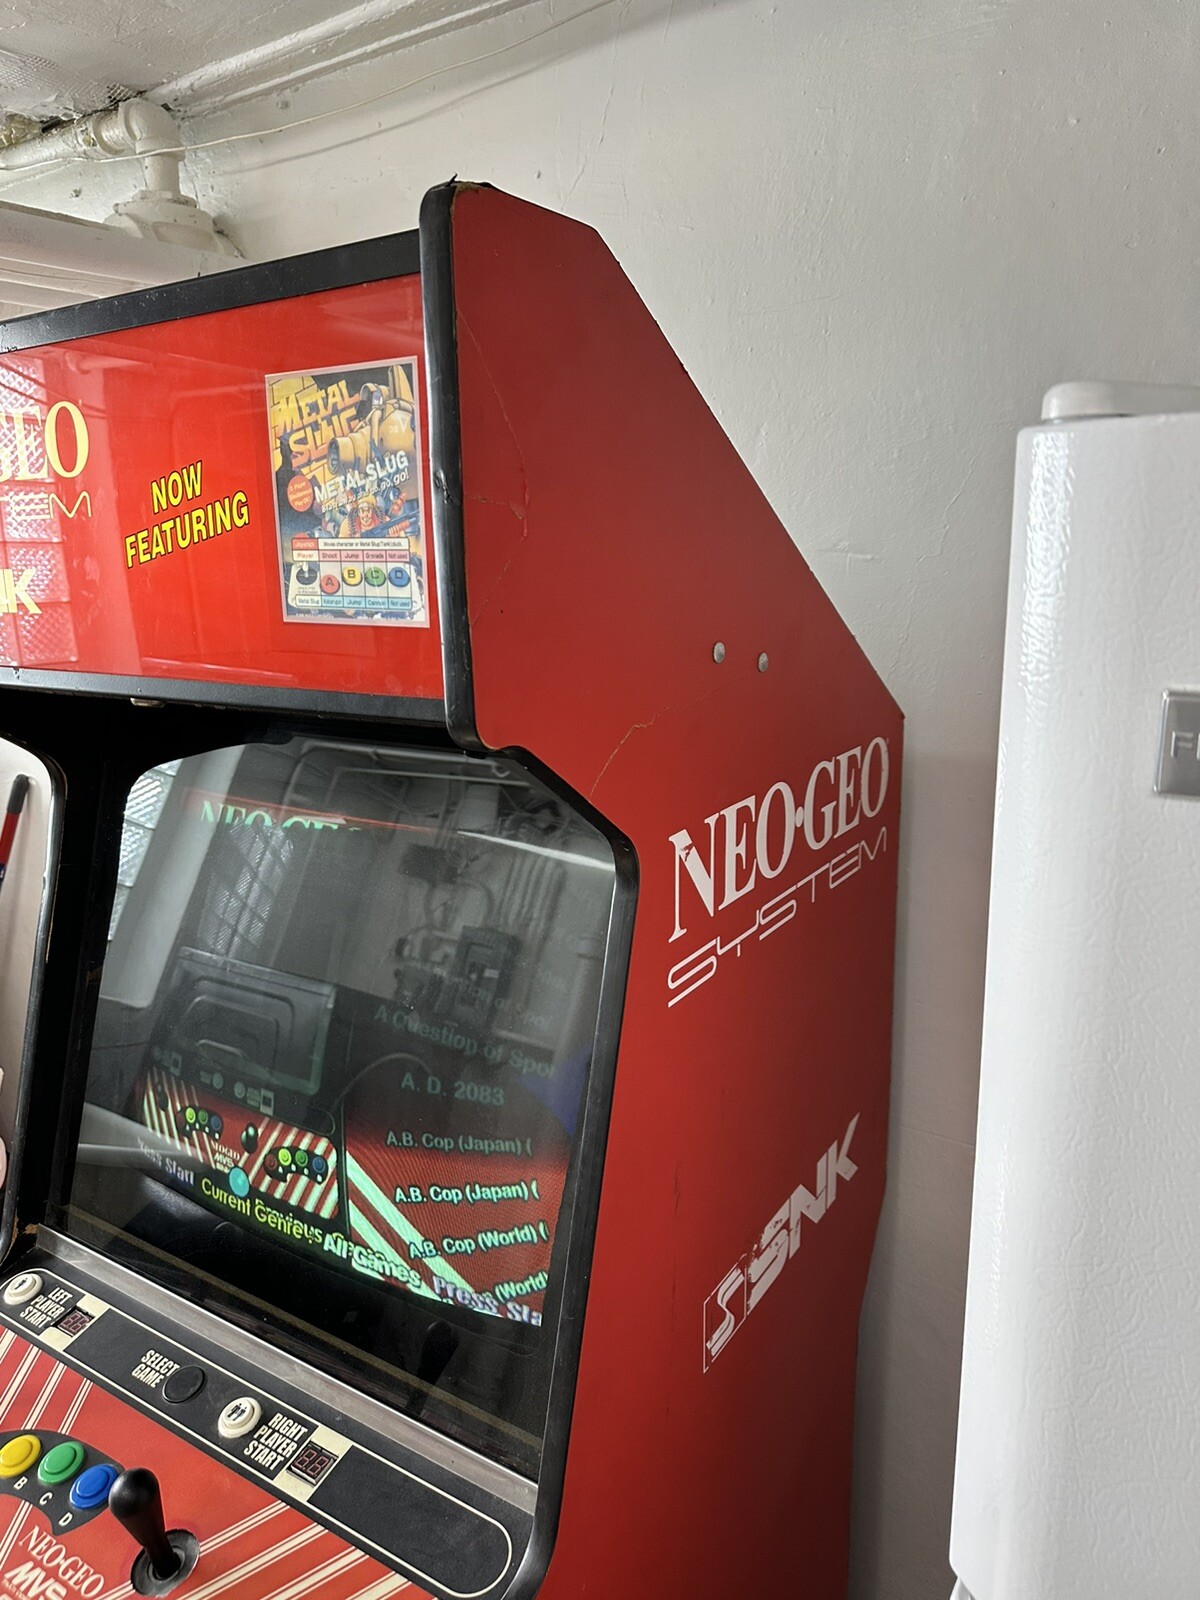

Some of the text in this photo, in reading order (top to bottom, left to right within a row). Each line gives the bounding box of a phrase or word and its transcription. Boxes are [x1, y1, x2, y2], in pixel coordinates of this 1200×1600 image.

[0, 401, 89, 484] EO
[150, 461, 203, 514] NOW
[314, 450, 409, 503] METAL SLUG
[125, 491, 250, 567] FEATURING
[344, 552, 360, 560] Jump
[325, 577, 335, 586] A
[347, 569, 356, 579] B
[370, 570, 380, 579] C
[394, 570, 404, 579] D
[667, 826, 887, 1008] SYSTEM
[454, 1080, 505, 1106] 2083
[387, 1130, 418, 1147] A.B.
[422, 1133, 455, 1151] Cop
[458, 1134, 521, 1155] (Japan)
[395, 1186, 427, 1203] A.B.
[429, 1184, 463, 1205] Cop
[465, 1181, 529, 1203] (Japan)
[201, 1177, 251, 1216] Current
[352, 1247, 423, 1288] Games
[408, 1241, 441, 1260] A.B.
[443, 1237, 477, 1256] Cop
[477, 1223, 538, 1249] (World)
[30, 1295, 66, 1319] PLAYER
[48, 1286, 73, 1305] LEFT
[433, 1275, 499, 1316] Press
[20, 1305, 52, 1329] START
[131, 1363, 165, 1389] GAME
[140, 1349, 181, 1377] SELECT
[267, 1412, 308, 1441] RIGHT
[253, 1424, 298, 1458] PLAYER
[243, 1440, 285, 1471] START
[13, 1476, 28, 1490] B
[39, 1492, 53, 1505] C
[58, 1512, 73, 1527] D
[4, 1561, 68, 1600] MVS
